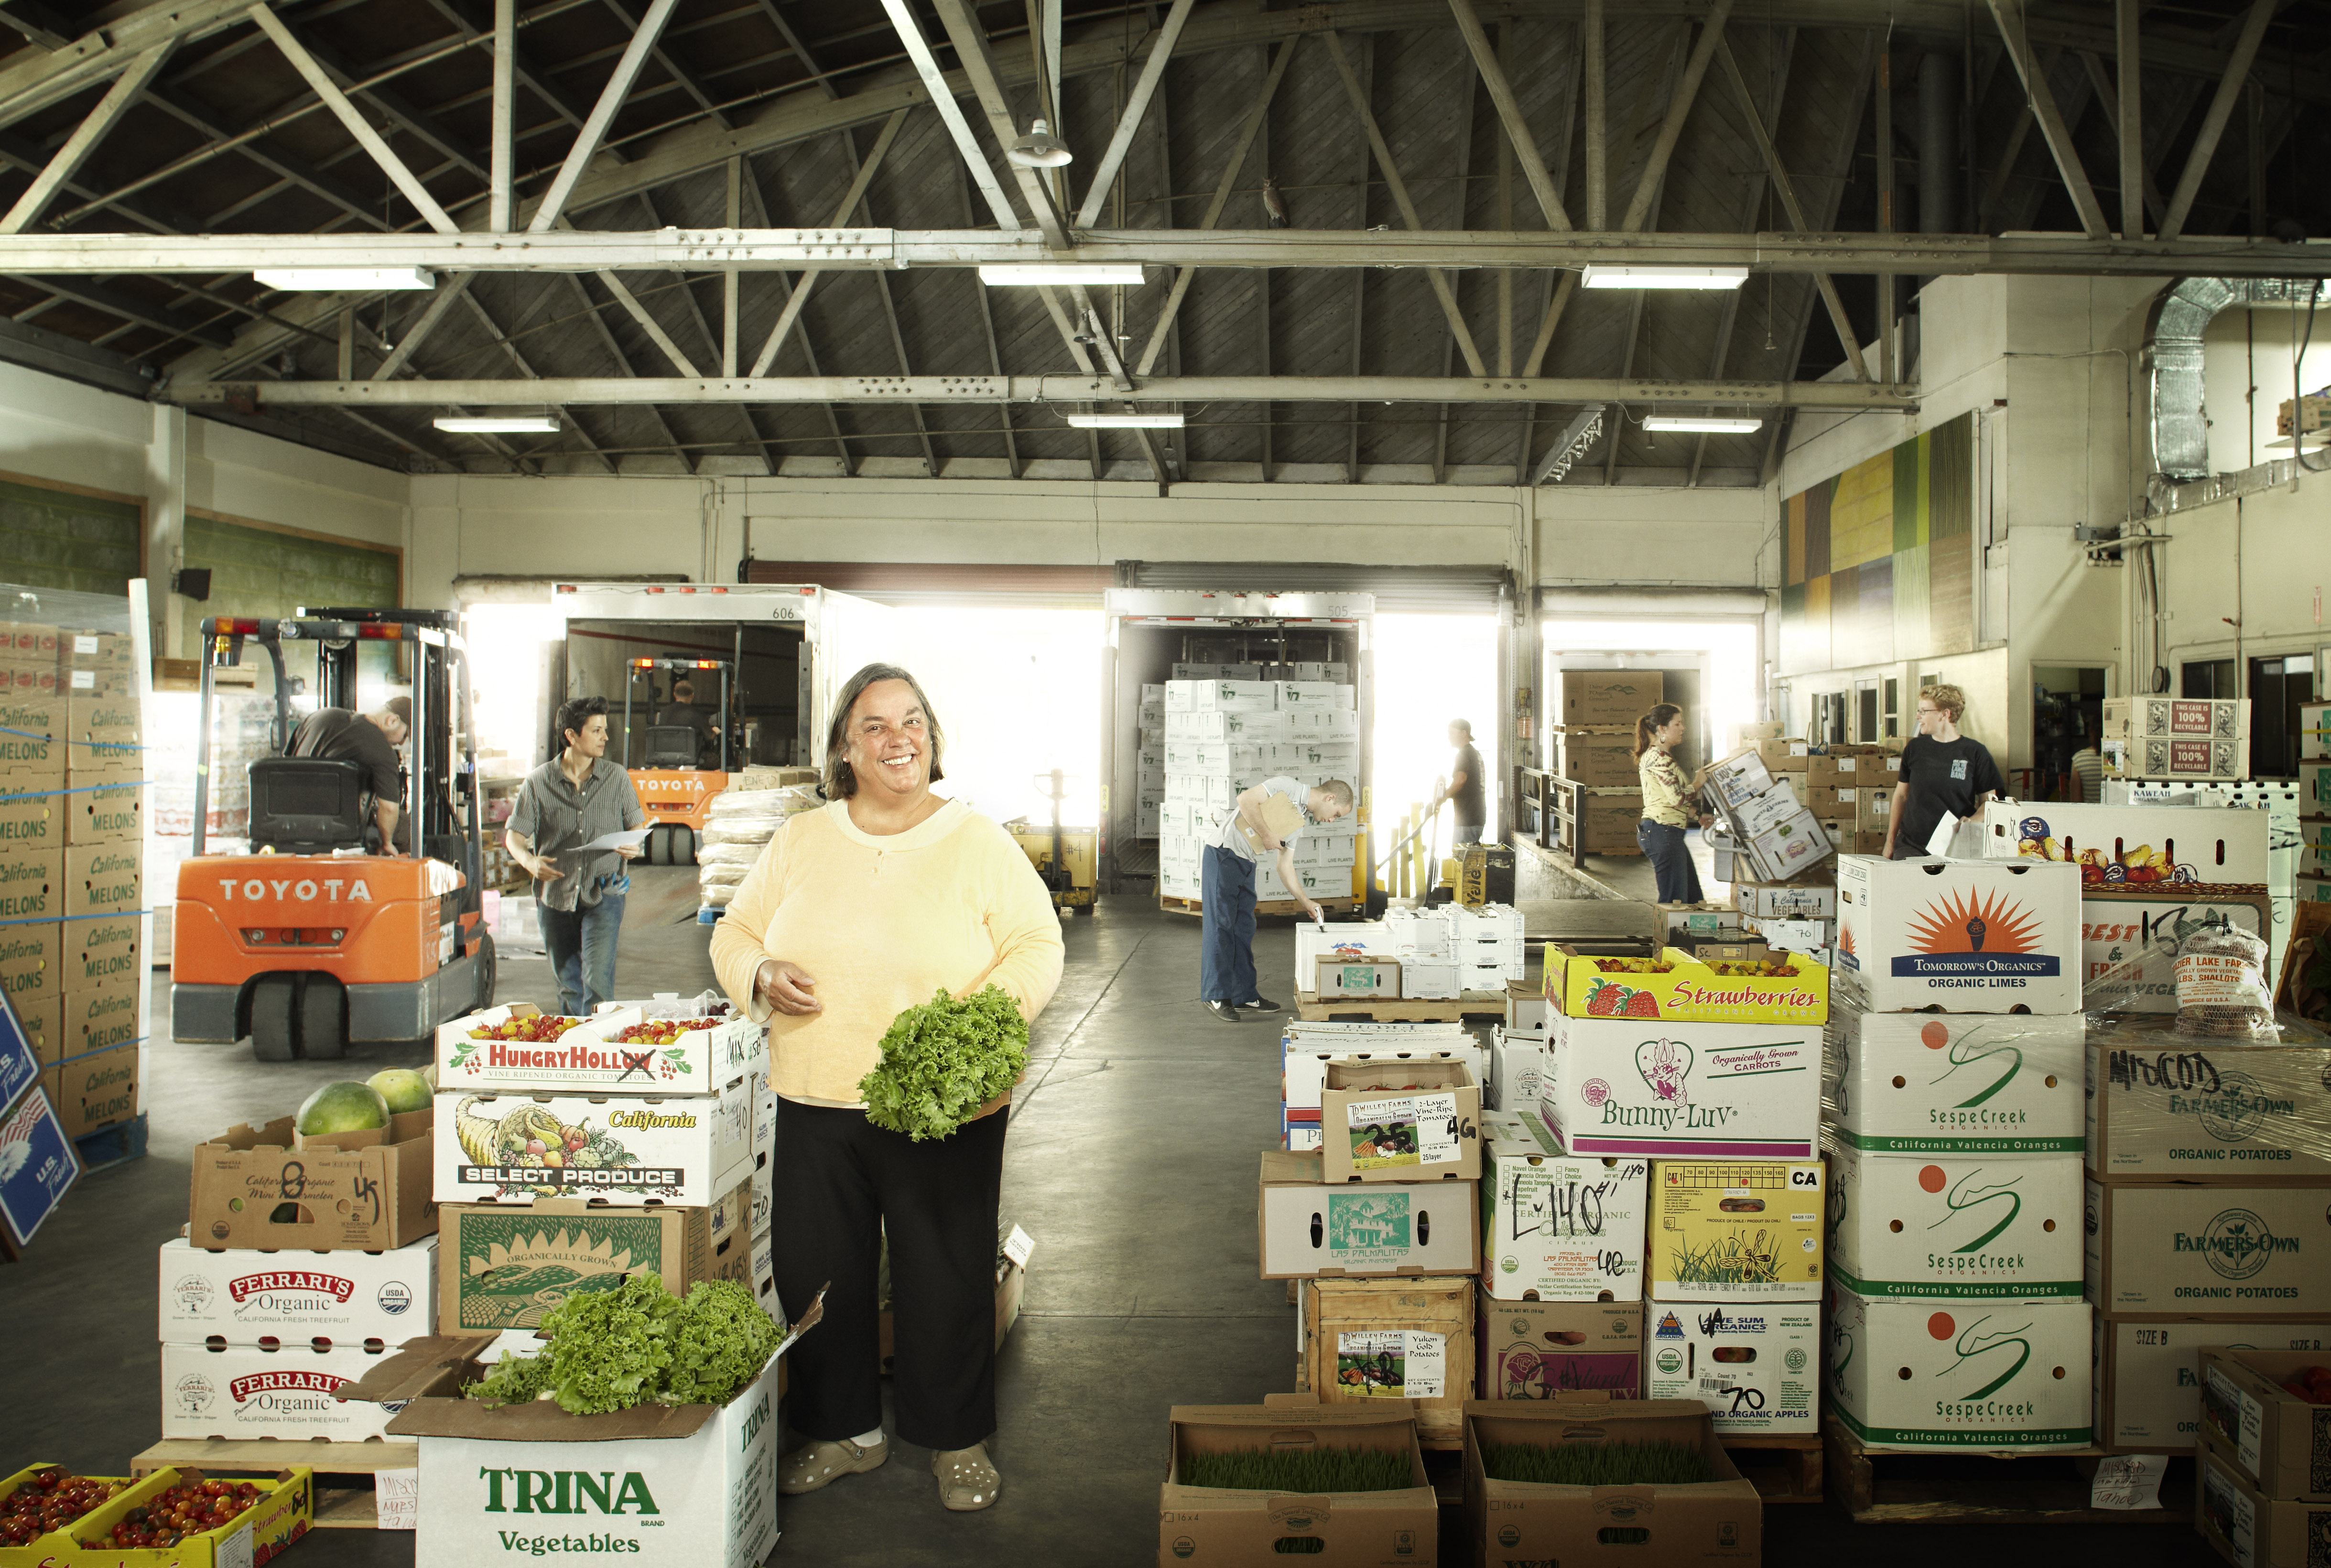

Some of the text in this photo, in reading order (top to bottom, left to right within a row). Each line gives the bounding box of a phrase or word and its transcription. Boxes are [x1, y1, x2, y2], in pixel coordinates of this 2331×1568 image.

[772, 607, 794, 619] 606
[1327, 605, 1348, 617] 505
[2178, 712, 2205, 723] 100%
[2177, 751, 2204, 762] 100%
[637, 779, 705, 792] TOYOTA
[2134, 789, 2171, 798] KAWEAH
[92, 812, 136, 832] MELONS
[1065, 840, 1084, 862] #4
[90, 854, 136, 875] California
[89, 884, 135, 905] MELONS
[219, 878, 372, 902] TOYOTA
[1787, 889, 1806, 898] Fresh
[1772, 905, 1821, 916] VEGETABLES
[87, 925, 133, 948] California
[1796, 929, 1812, 938] 70
[2082, 923, 2140, 942] BEST
[86, 954, 132, 978] MELONS
[1914, 959, 2042, 972] TOMORROW'S ORGANICS
[2196, 957, 2220, 966] LAKE
[2090, 962, 2143, 981] FRESH
[1928, 978, 2027, 988] ORGANIC LIMES
[2178, 974, 2240, 983] LBS. SHALLOTS
[1666, 980, 1821, 1009] Strawberries
[1675, 1007, 1754, 1015] CALIFORNIA
[1712, 1048, 1799, 1067] Organically Grown
[1734, 1059, 1781, 1072] CARROTS
[488, 1071, 652, 1081] VINE RIPENED ORGANIC TOMATOES
[1359, 1100, 1412, 1112] WILLEY FARMS
[1419, 1099, 1448, 1108] 2-Layer
[1415, 1105, 1453, 1115] Vine-Ripe
[609, 1110, 697, 1132] California
[1416, 1114, 1454, 1123] Tomatoes
[1889, 1140, 2061, 1151] California Valencia Oranges
[2169, 1149, 2292, 1160] ORGANIC POTATOES
[35, 1155, 57, 1183] U.S.
[466, 1168, 676, 1185] SELECT PRODUCE
[1792, 1171, 1817, 1186] CA
[248, 1188, 334, 1200] Mini Wermelon
[2173, 1232, 2299, 1254] FARMER'S OWN
[1331, 1247, 1409, 1258] LAS PALMALITAS
[506, 1252, 618, 1269] ORGANICALLY GROWN
[232, 1273, 351, 1296] FERRARI'S
[385, 1288, 404, 1297] USDA
[2174, 1287, 2298, 1298] ORGANIC POTATOES
[233, 1297, 258, 1318] Premium
[259, 1294, 331, 1314] Organic
[383, 1298, 407, 1306] ORGANIC
[1351, 1332, 1403, 1342] WILLEY FARMS
[1412, 1335, 1438, 1344] Yukon
[2136, 1330, 2168, 1345] SIZE B
[1416, 1342, 1433, 1351] Gold
[259, 1393, 331, 1415] Organic
[1720, 1386, 1765, 1414] 70
[1728, 1410, 1772, 1418] ORGANIC
[741, 1391, 770, 1454] TRINA
[1895, 1432, 2068, 1443] California Valencia Oranges
[479, 1465, 660, 1515] TRINA
[1280, 1508, 1320, 1519] Natural Trading
[498, 1530, 640, 1556] Vegetables
